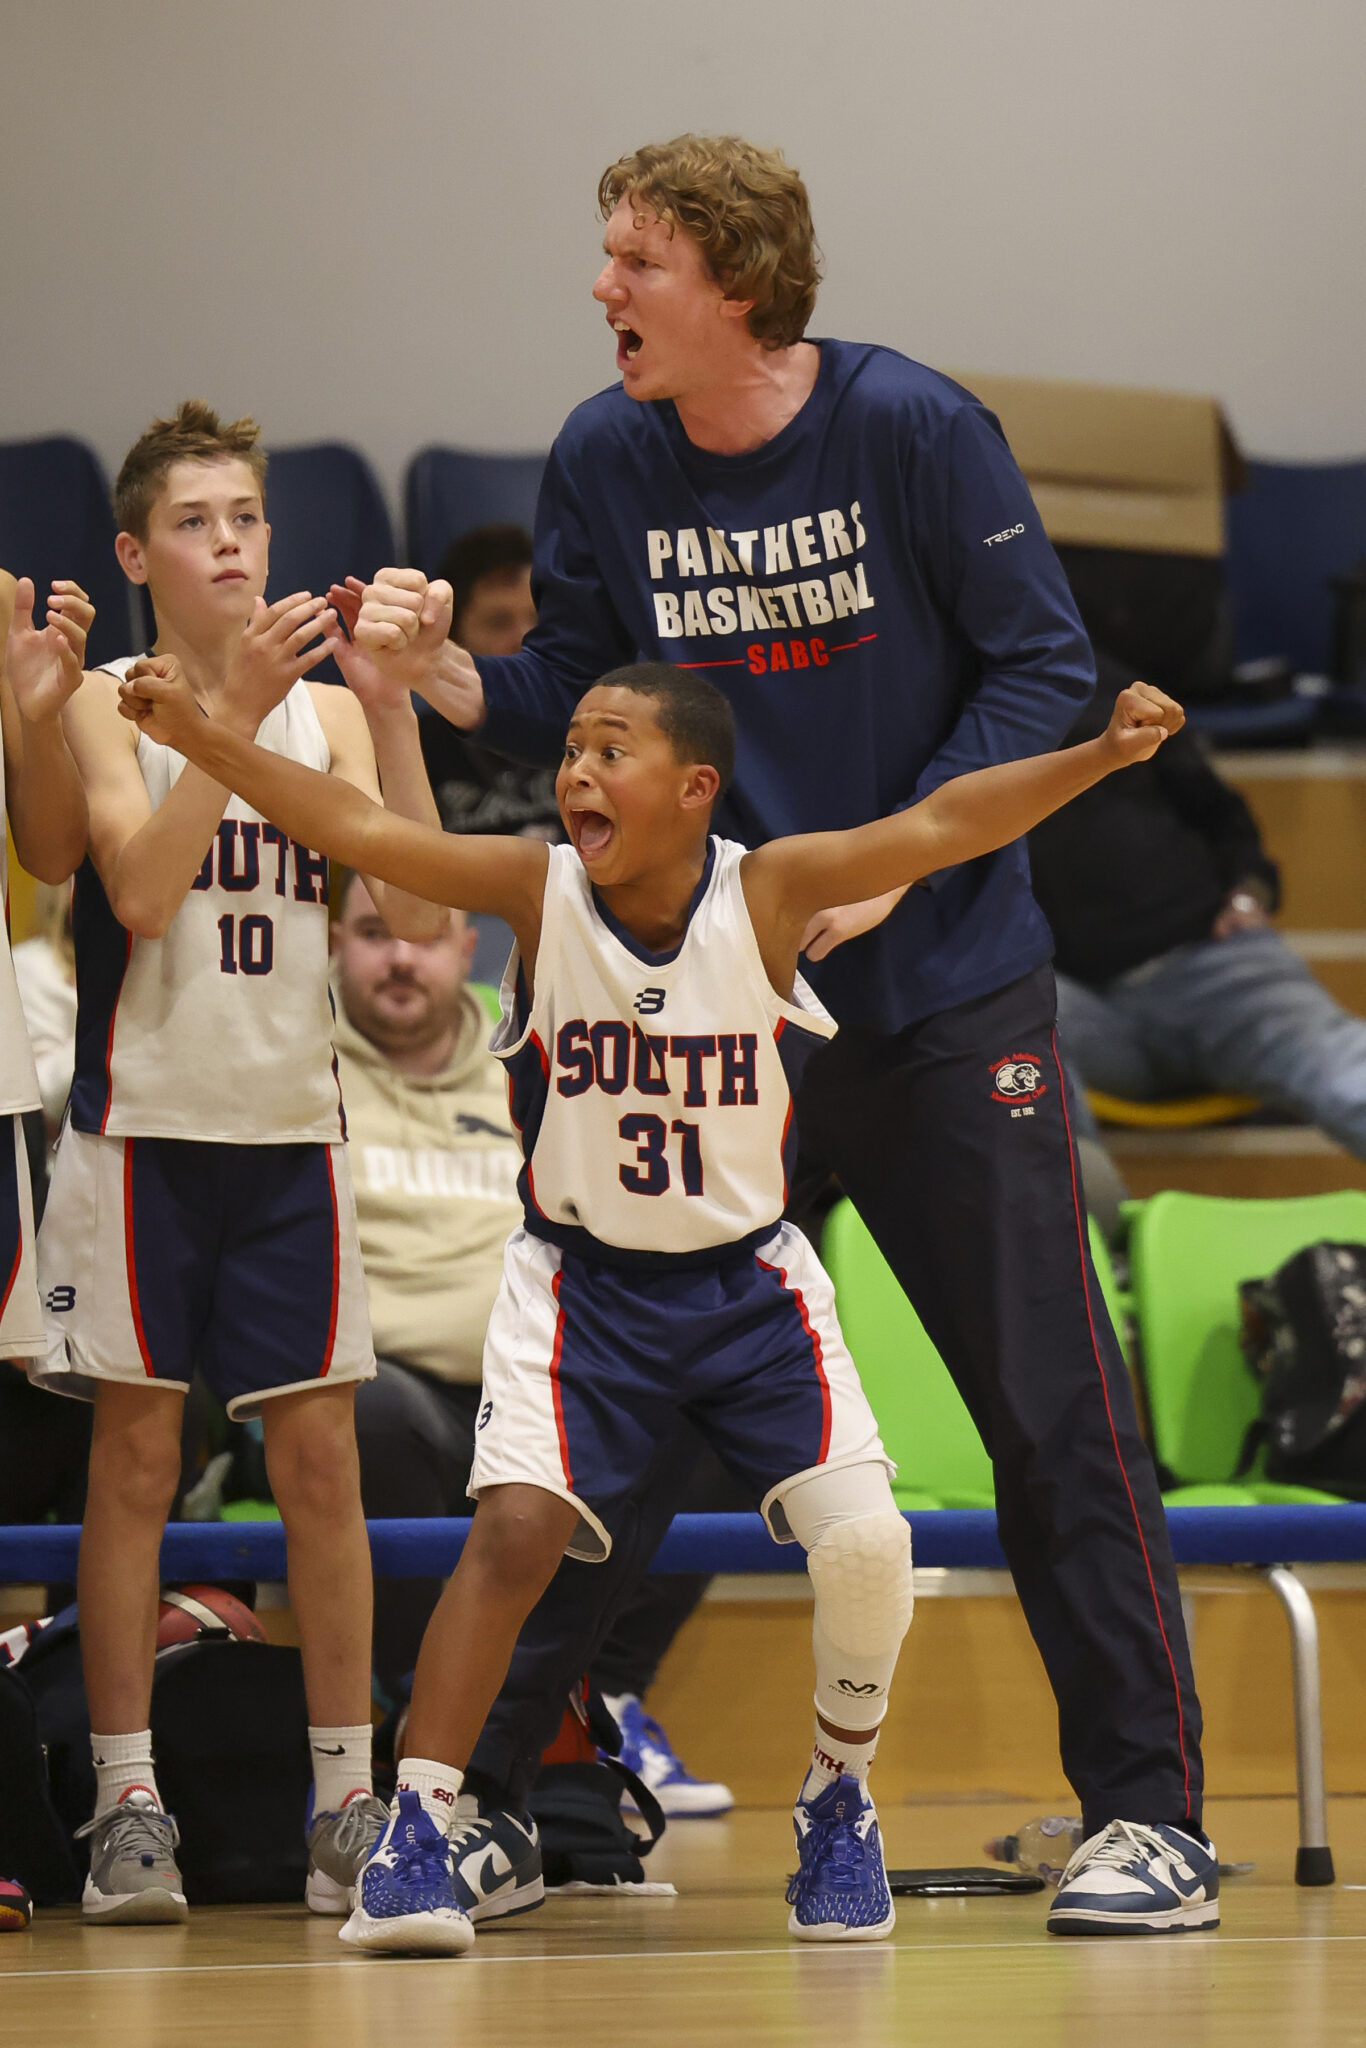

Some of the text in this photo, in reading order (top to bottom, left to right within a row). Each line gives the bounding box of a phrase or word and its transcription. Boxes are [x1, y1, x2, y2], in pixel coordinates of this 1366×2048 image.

[982, 522, 1025, 547] TREND
[747, 632, 830, 675] SABC
[217, 913, 274, 976] 10
[556, 1018, 759, 1108] SOUTH
[618, 1112, 705, 1197] 31
